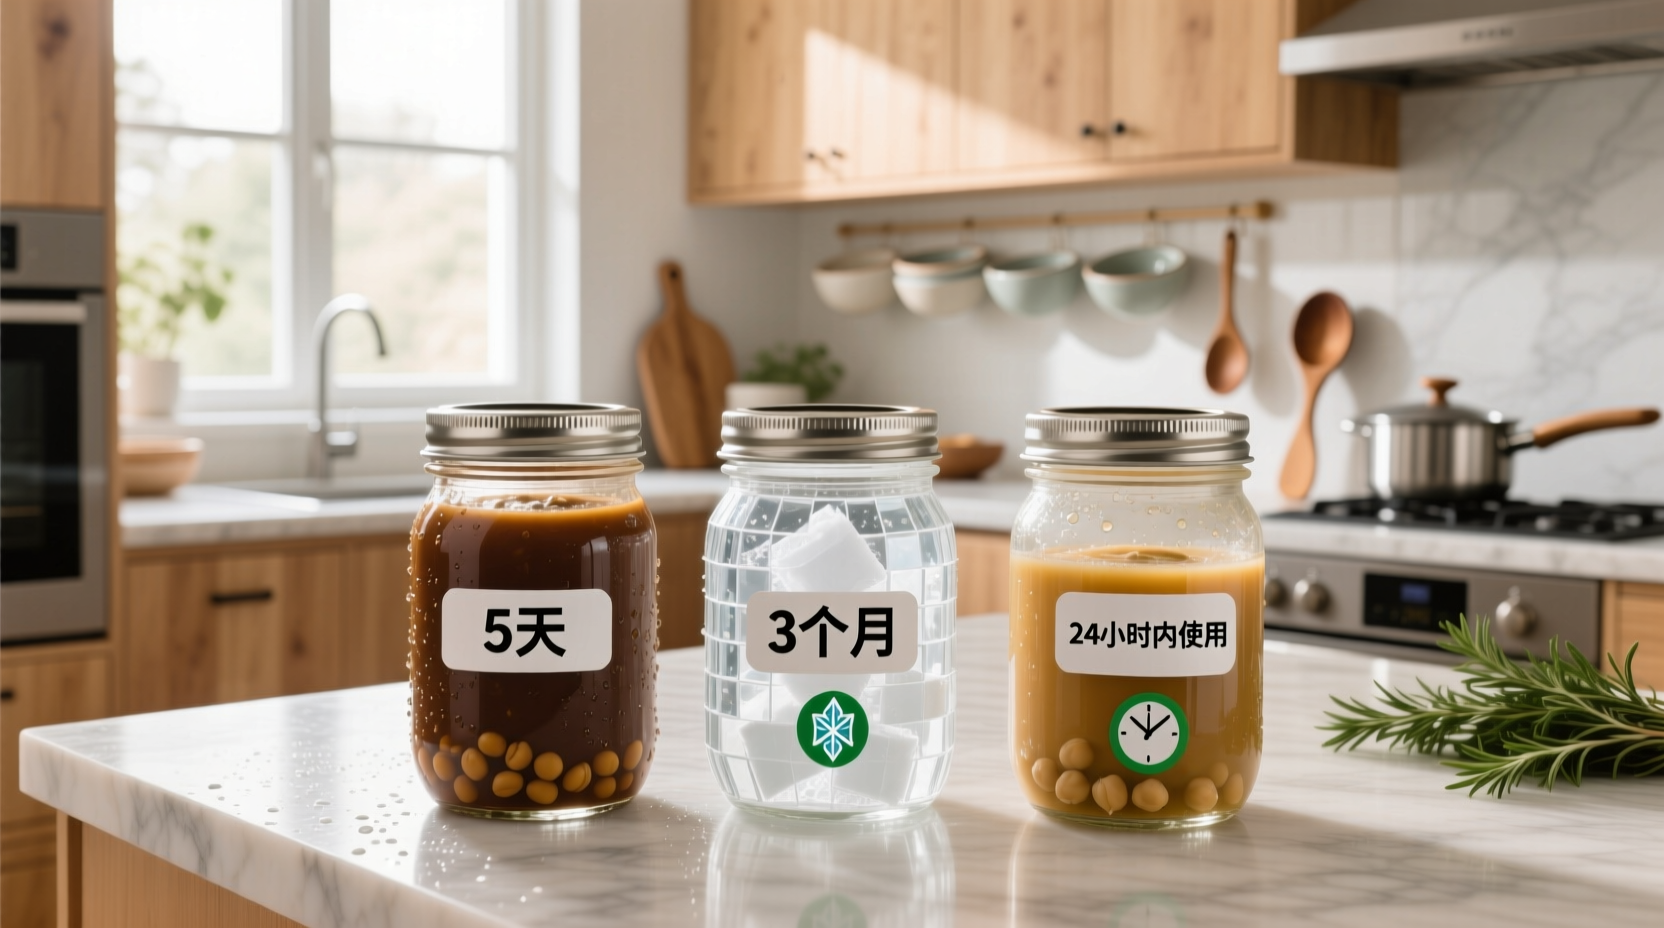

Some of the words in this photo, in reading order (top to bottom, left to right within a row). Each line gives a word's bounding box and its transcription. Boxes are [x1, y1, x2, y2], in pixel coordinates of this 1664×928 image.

[483, 608, 566, 657] 5天
[767, 605, 893, 658] 3个月
[1069, 620, 1227, 649] 24小时内使用
